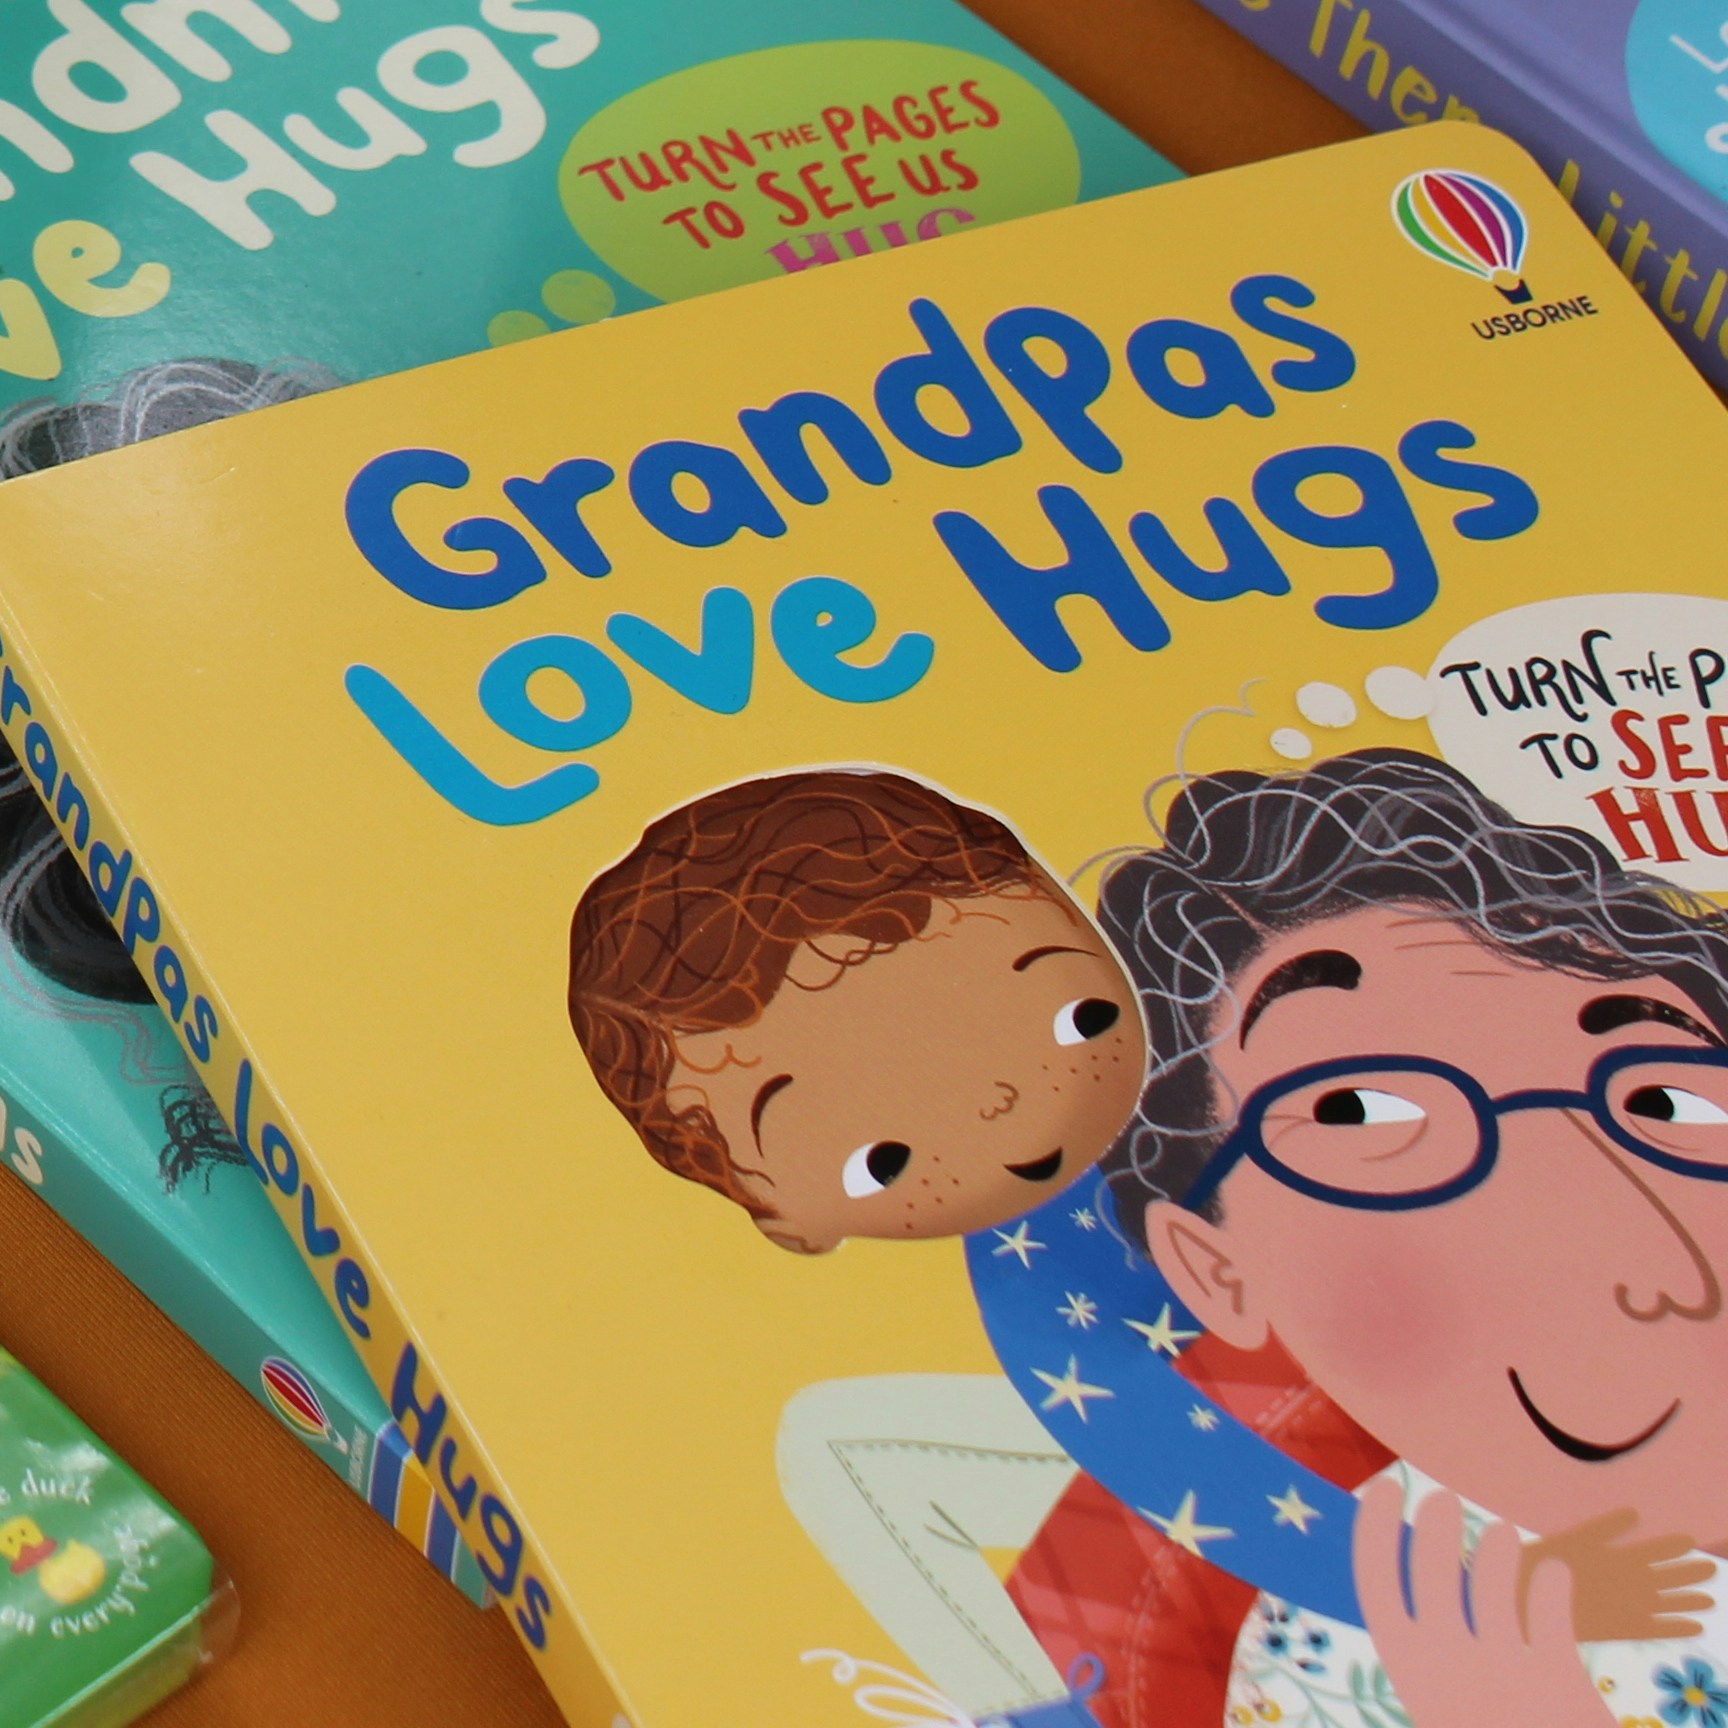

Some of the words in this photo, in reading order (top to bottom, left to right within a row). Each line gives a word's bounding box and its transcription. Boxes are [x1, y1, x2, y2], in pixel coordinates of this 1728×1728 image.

[578, 127, 758, 203] TURN
[751, 119, 822, 156] THE
[822, 78, 1003, 154] PAGES
[661, 199, 746, 251] TO
[755, 153, 897, 228] SEE
[897, 147, 980, 197] US
[1470, 294, 1600, 342] USBORNE
[344, 273, 1357, 612] Grandpas
[344, 575, 936, 827] Love
[932, 418, 1541, 674] Hugs
[1439, 629, 1618, 722] TURN
[1615, 649, 1682, 697] THE
[1518, 732, 1600, 779] TO
[231, 1058, 373, 1340] Love
[390, 1338, 552, 1652] Hugs
[20, 1466, 92, 1506] duck
[49, 1587, 137, 1639] every
